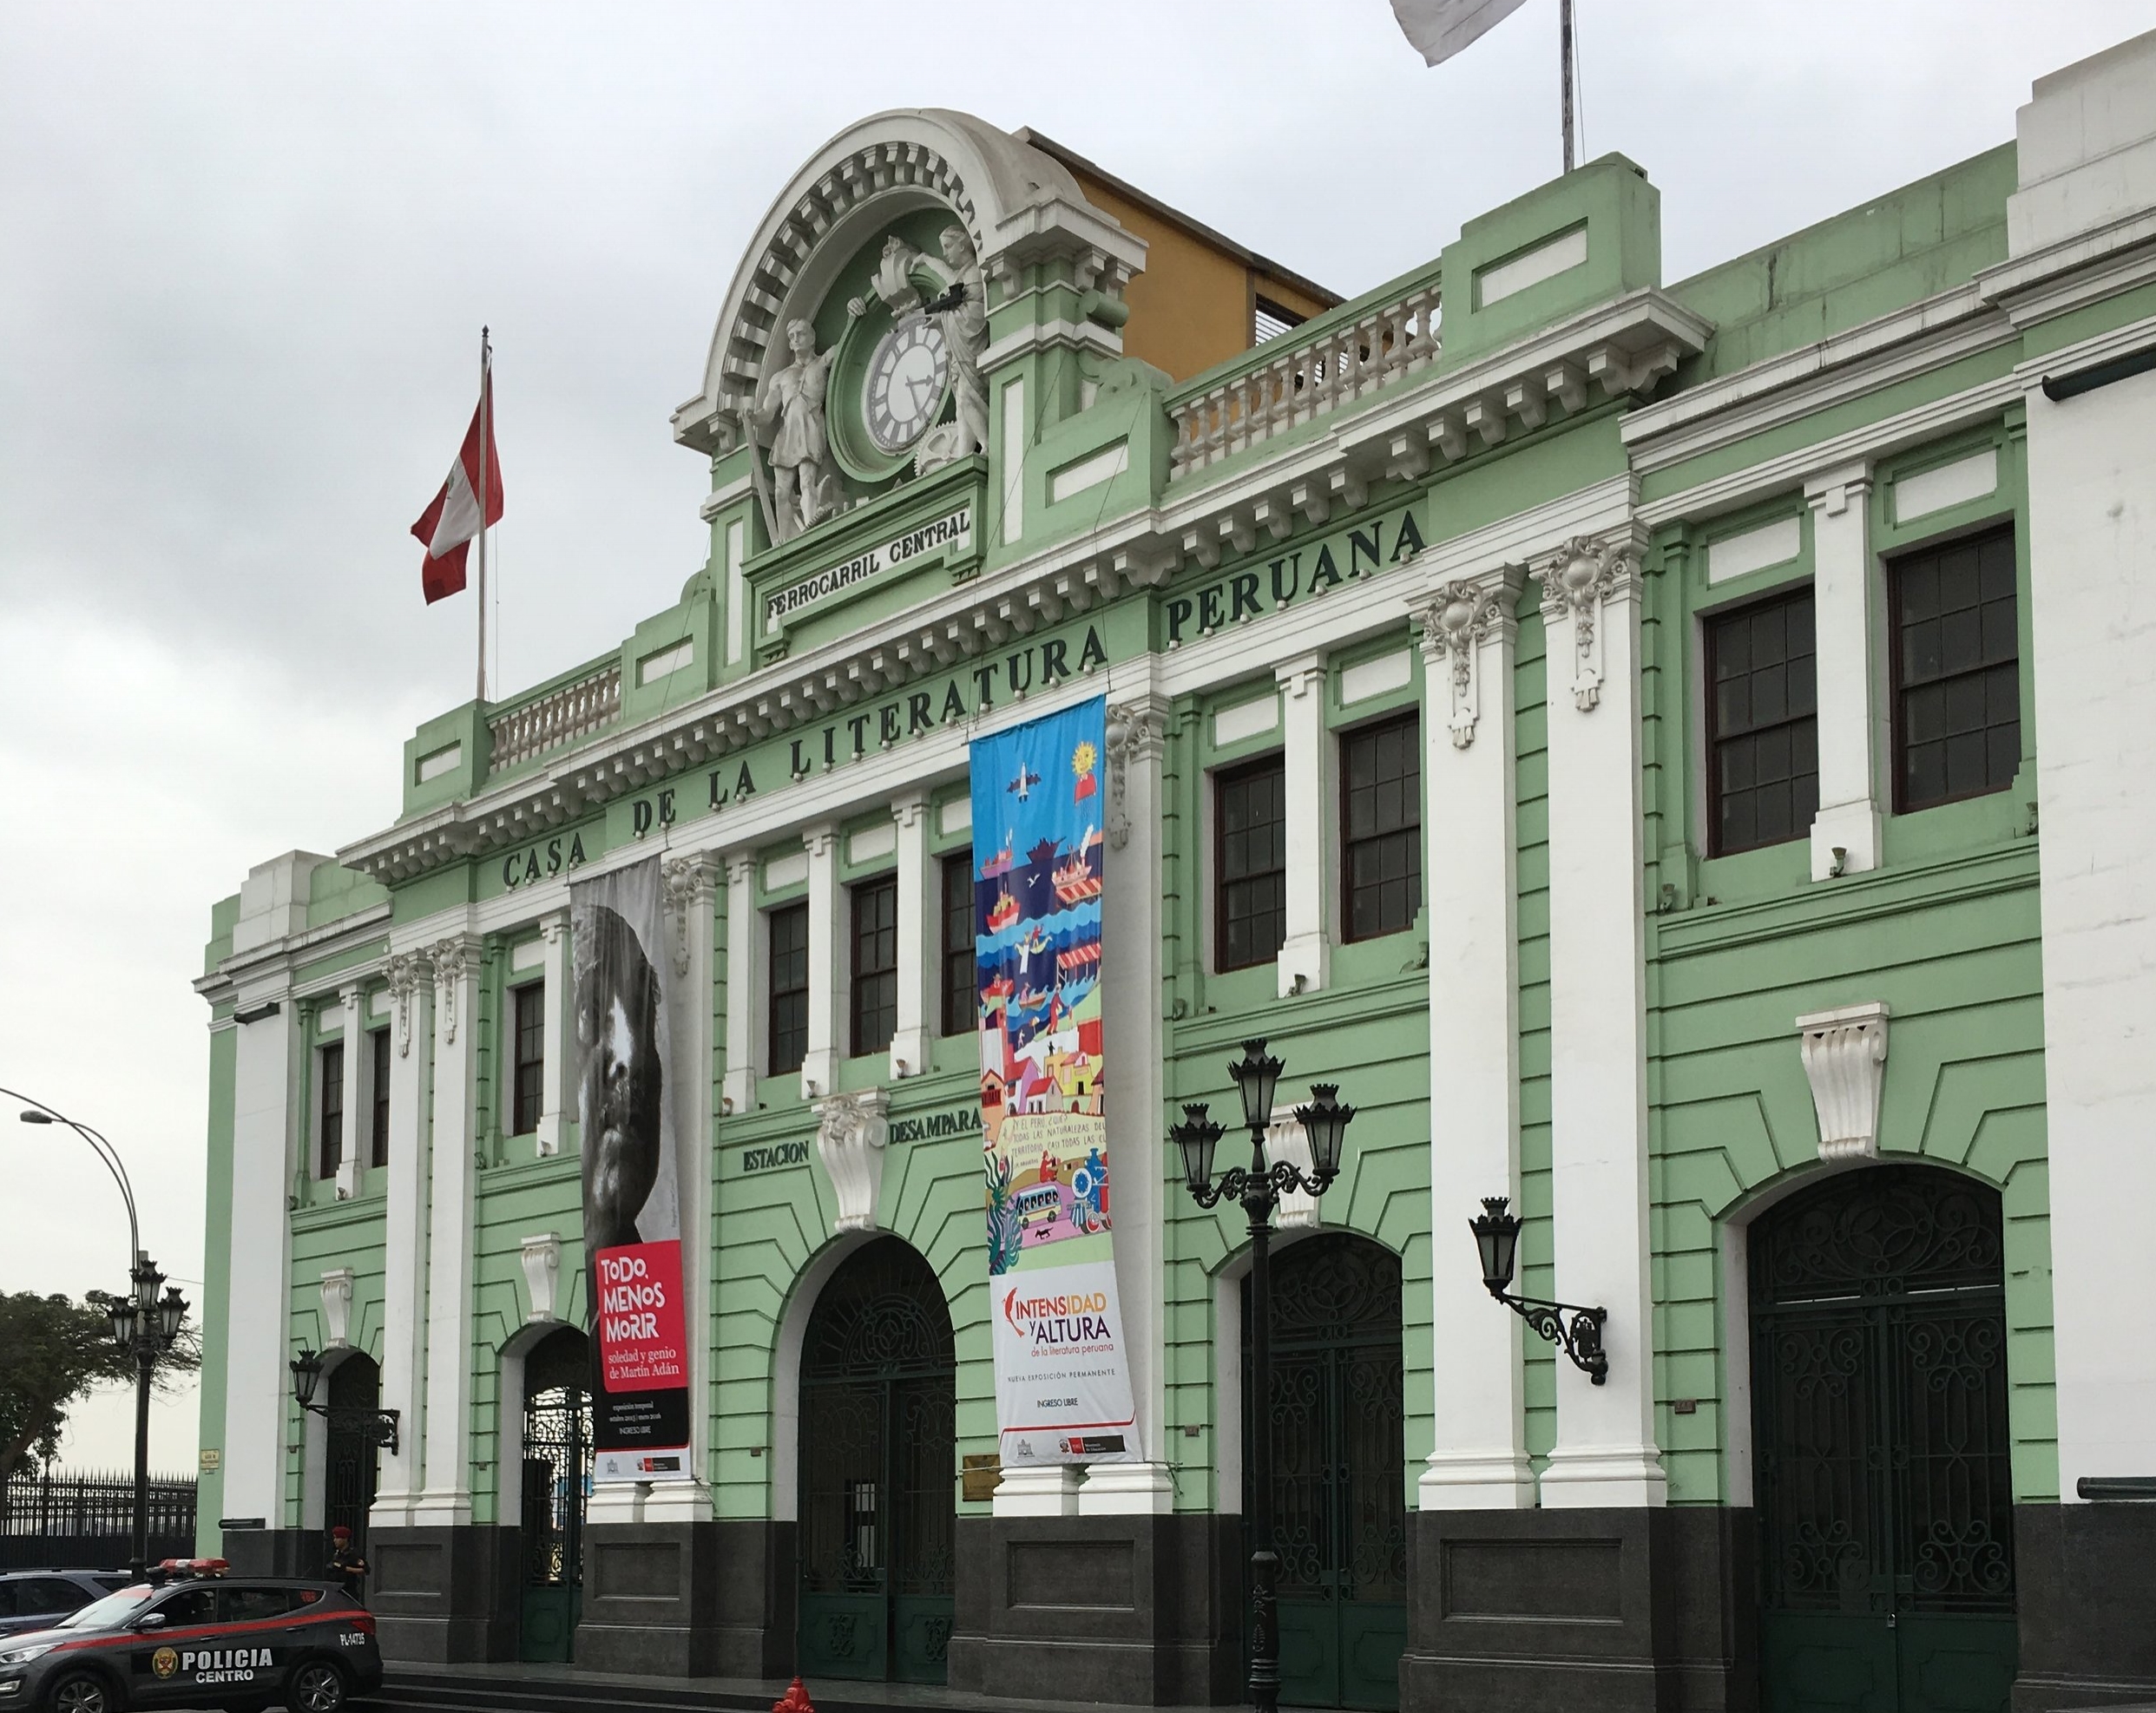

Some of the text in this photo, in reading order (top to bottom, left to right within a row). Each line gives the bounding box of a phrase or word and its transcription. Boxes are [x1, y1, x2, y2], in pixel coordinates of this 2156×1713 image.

[766, 512, 970, 619] FERROCARRIL CENTRAL
[503, 509, 1428, 888] CASA DE LA LITERATURA PERUANA
[1034, 1130, 1043, 1139] LAS
[1048, 1124, 1089, 1137] NATURALEZAS
[1062, 1137, 1080, 1148] TODAS
[1083, 1135, 1095, 1145] LAS
[743, 1140, 810, 1172] ESTACION
[604, 1282, 666, 1314] MENOS
[1016, 1292, 1107, 1320] INTENSIDAD
[606, 1312, 660, 1342] MORIR
[1035, 1315, 1111, 1344] ALTURA
[608, 1346, 676, 1364] soledad y genio
[1031, 1343, 1114, 1357] de la literatura peruana
[609, 1362, 680, 1380] de Martín Adán
[1008, 1368, 1115, 1382] NUEVA EXPOSICIÓN PERMANENTE
[1036, 1397, 1078, 1408] INGRESO LIBRE
[182, 1648, 273, 1670] POLICIA
[195, 1670, 253, 1683] CENTRO
